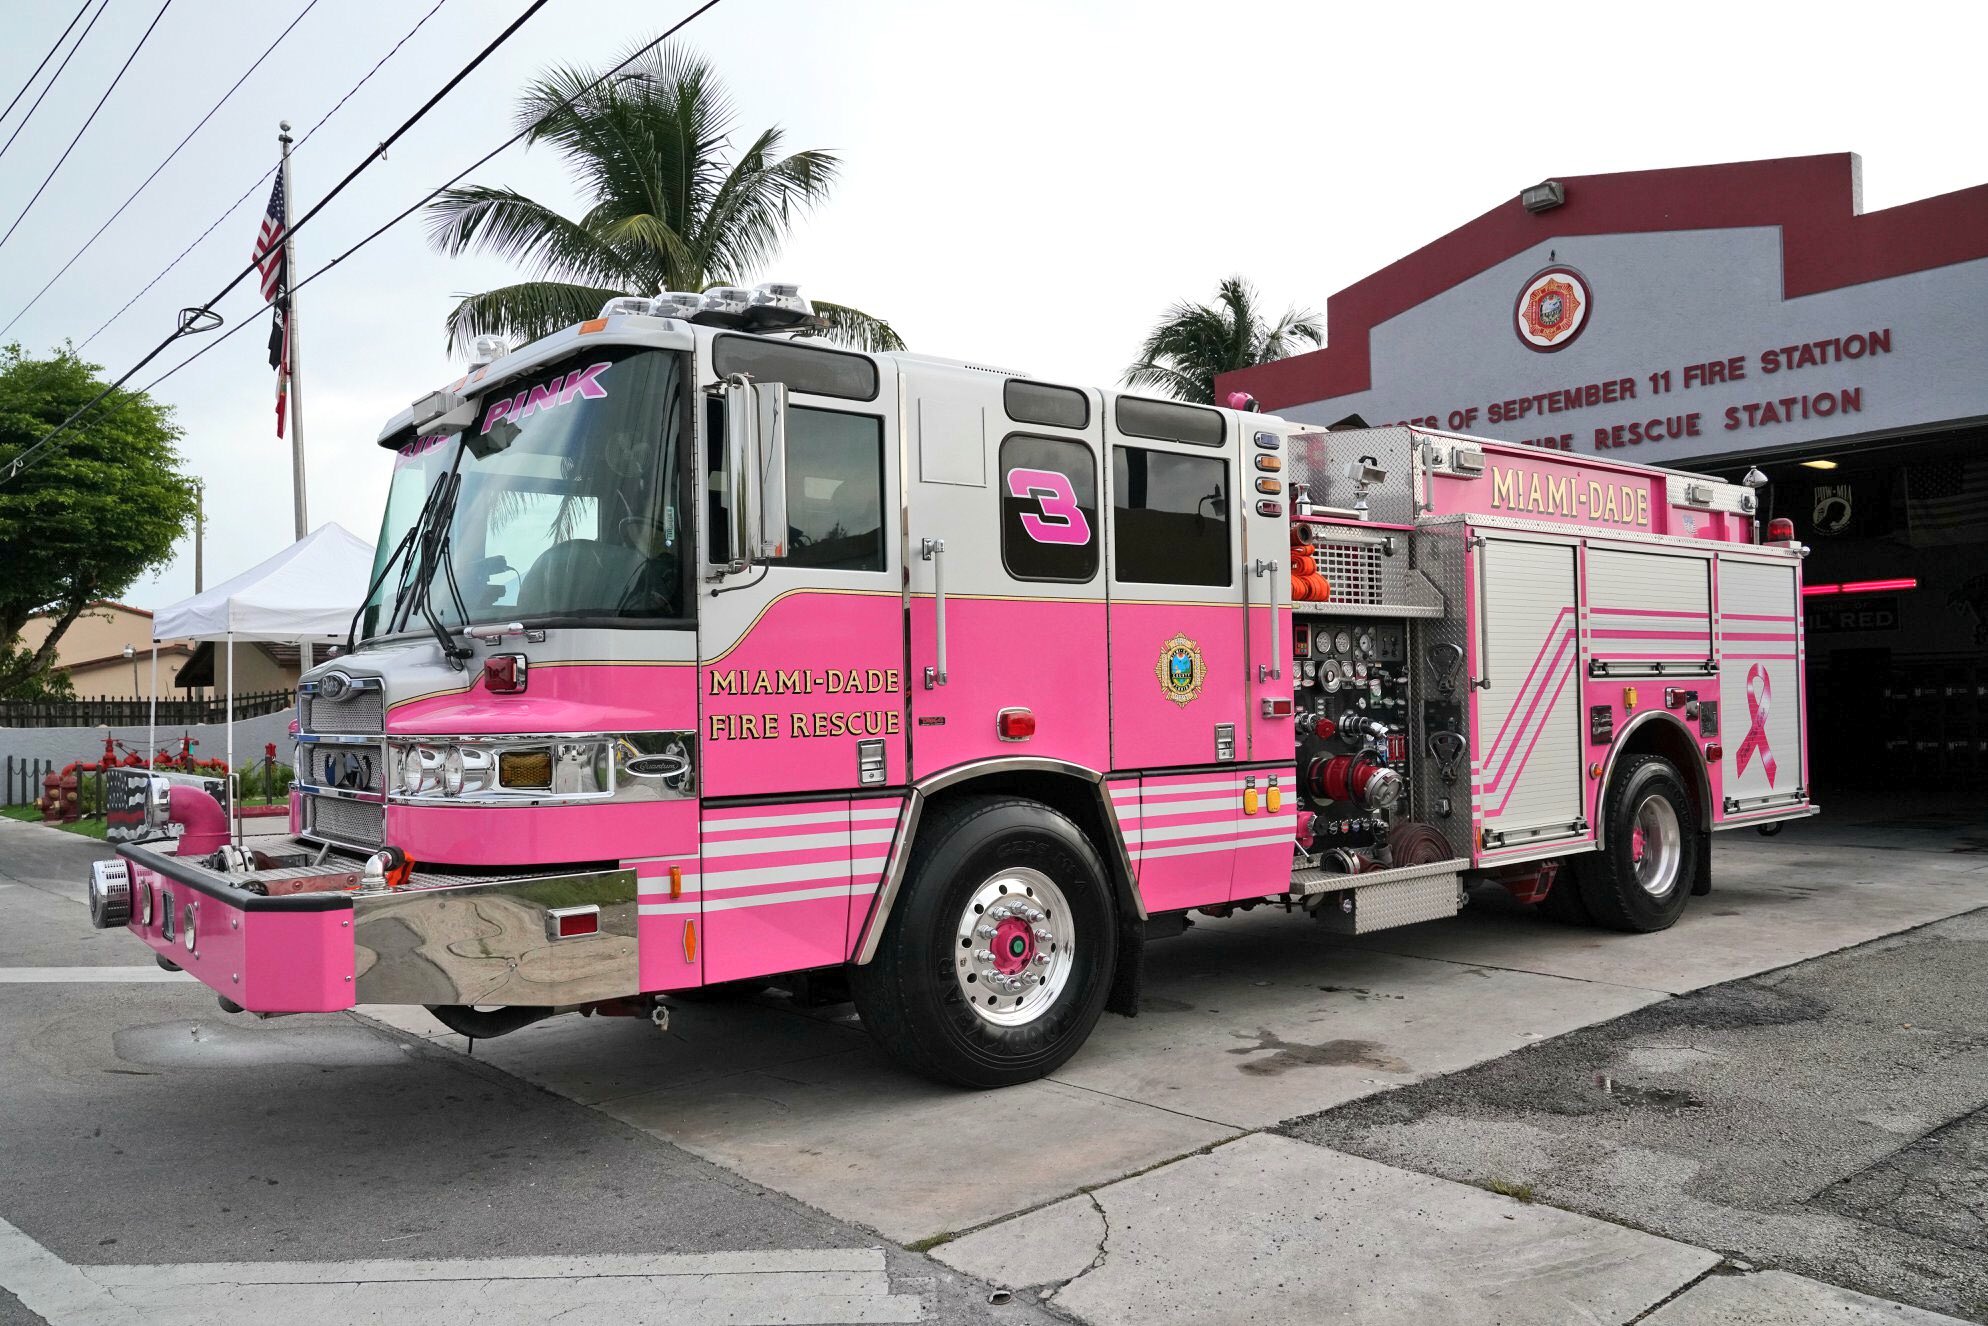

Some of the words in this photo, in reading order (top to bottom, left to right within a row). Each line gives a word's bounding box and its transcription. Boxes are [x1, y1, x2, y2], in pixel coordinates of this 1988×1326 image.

[480, 361, 613, 436] PINK
[1447, 406, 1479, 431] OF
[1487, 377, 1637, 424] SEPTEMBER
[1648, 370, 1672, 395] 11
[1683, 356, 1747, 389] FIRE
[1760, 328, 1892, 374] STATION
[1521, 433, 1575, 453] IRE
[1594, 412, 1703, 450] RESCUE
[1724, 387, 1862, 431] STATION
[1007, 467, 1091, 546] 3
[1491, 466, 1648, 526] MIAMI-DADE
[1839, 610, 1894, 629] RED
[709, 669, 899, 695] MIAMI-DADE
[709, 713, 780, 741] FIRE
[790, 710, 900, 738] RESCUE
